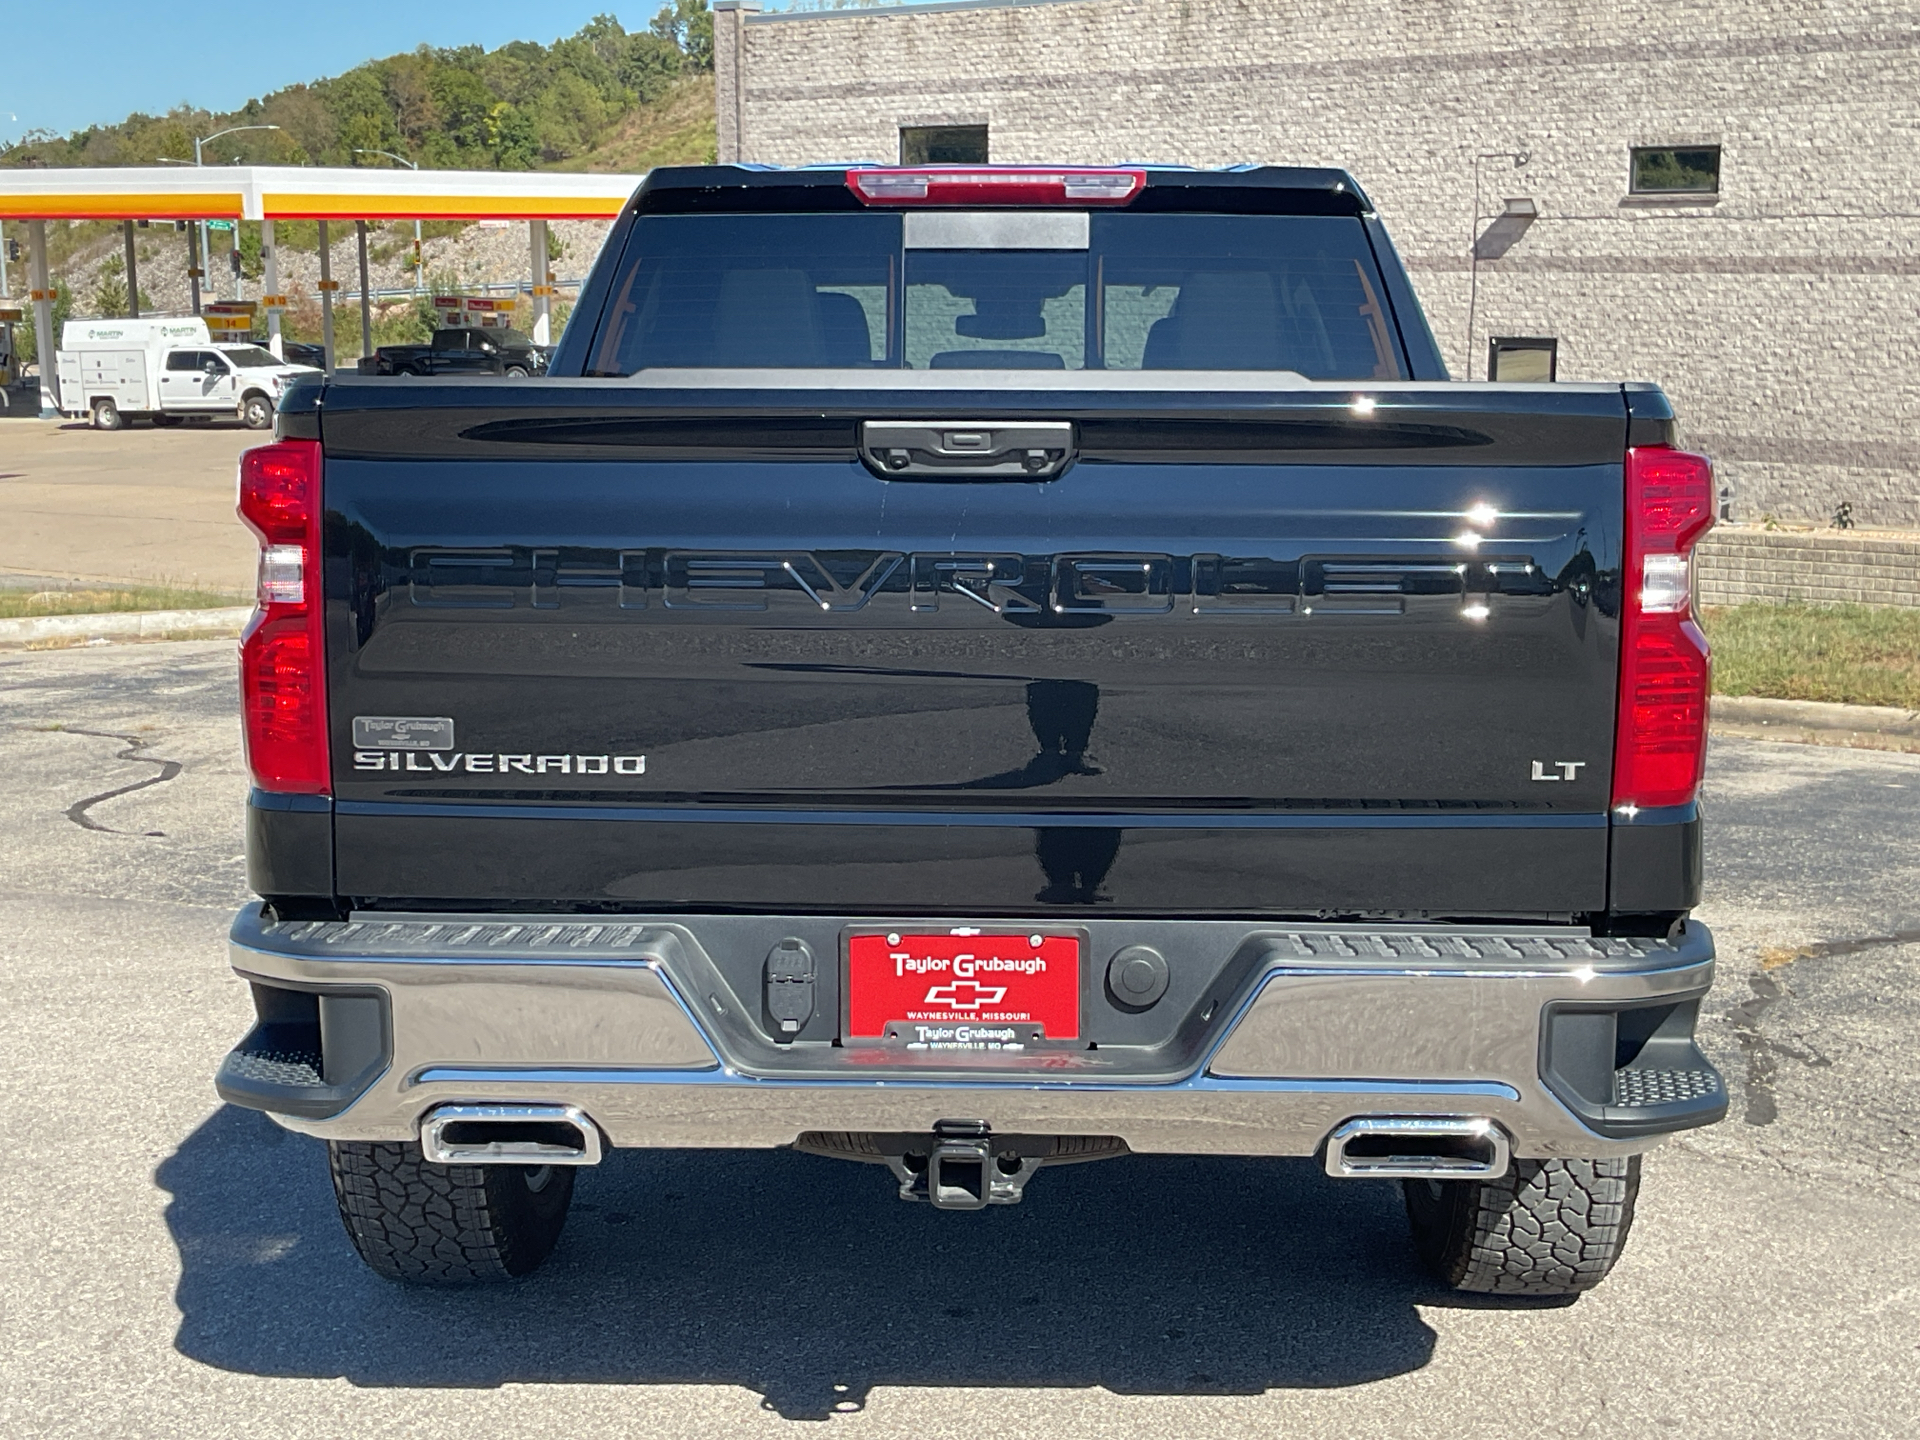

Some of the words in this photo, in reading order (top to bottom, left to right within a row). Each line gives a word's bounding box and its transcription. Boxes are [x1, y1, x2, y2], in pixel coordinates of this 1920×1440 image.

[226, 319, 236, 328] 14
[409, 547, 1535, 617] CHEVROLET
[361, 719, 394, 733] Taylor
[395, 720, 445, 733] Grubaugh
[353, 751, 647, 775] SILVERADO
[1531, 760, 1586, 781] LT
[890, 953, 950, 977] Taylor
[953, 954, 1047, 978] Grubaugh
[906, 1011, 979, 1021] WAYNESVILLE,
[982, 1012, 1031, 1021] MISSOURI
[915, 1026, 954, 1041] Taylor
[955, 1026, 1015, 1042] Grubaugh
